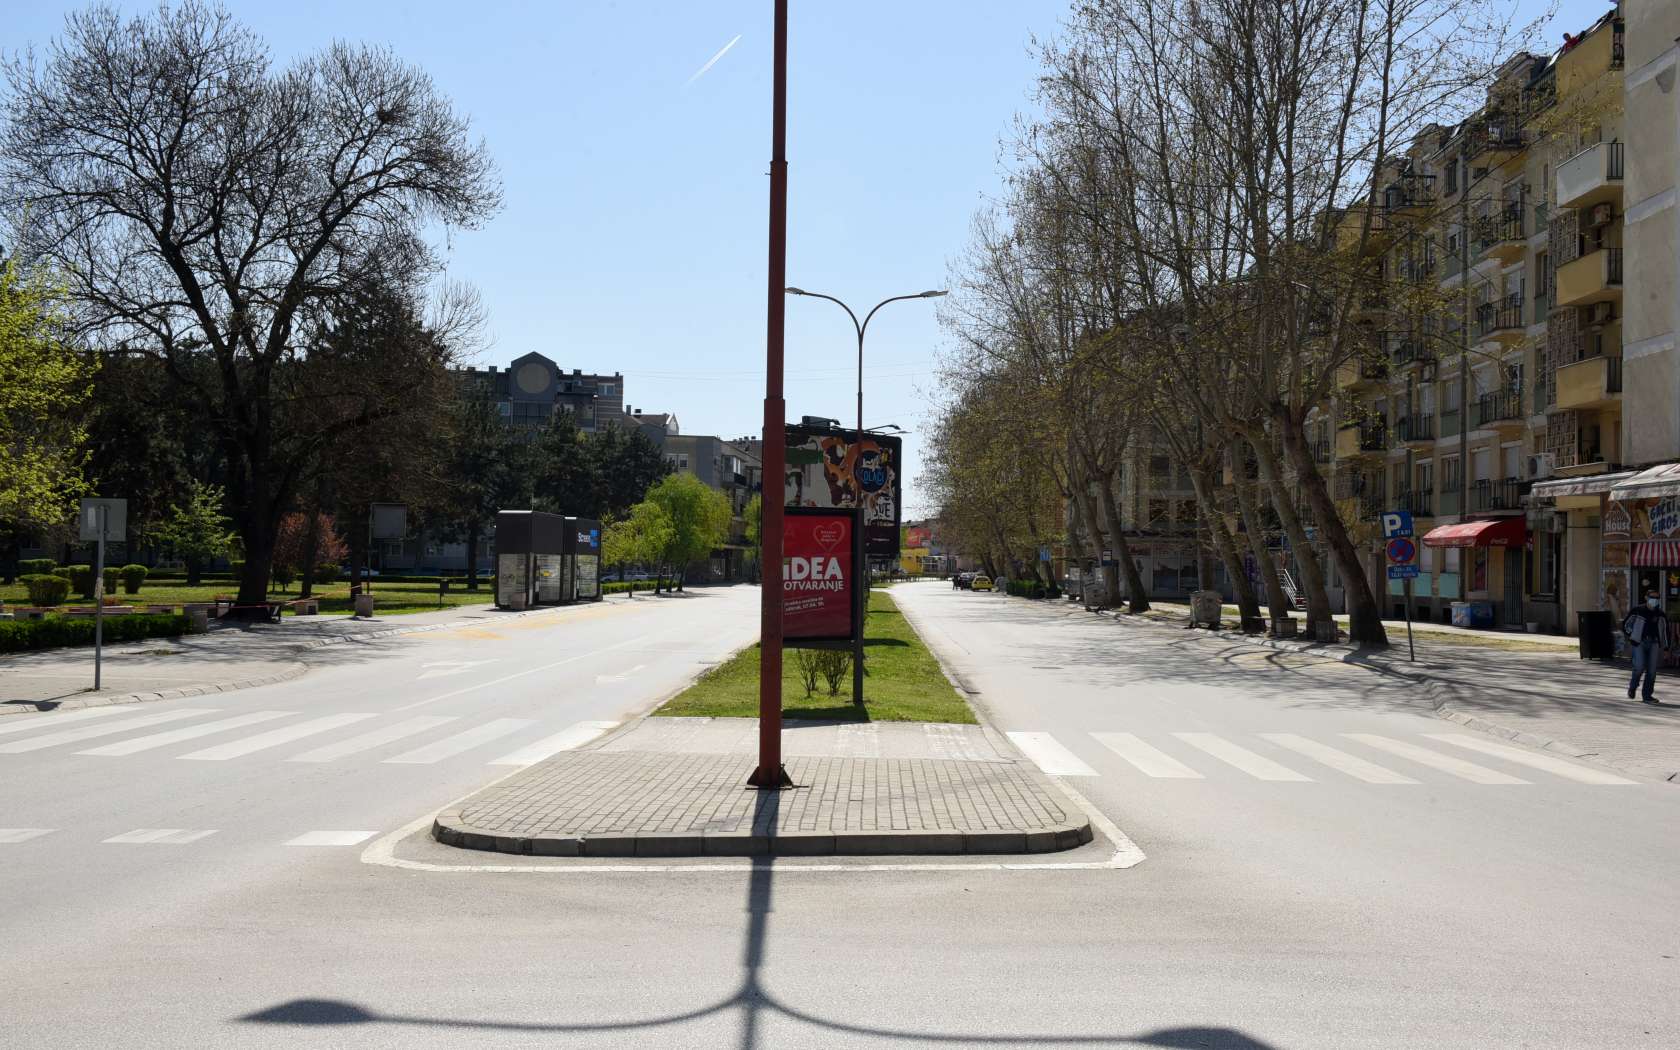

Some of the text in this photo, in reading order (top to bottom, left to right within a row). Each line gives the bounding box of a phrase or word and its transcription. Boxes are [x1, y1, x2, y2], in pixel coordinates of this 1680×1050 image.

[1383, 514, 1402, 537] P
[1651, 514, 1678, 534] GIROS
[783, 580, 845, 592] OTVARANJE
